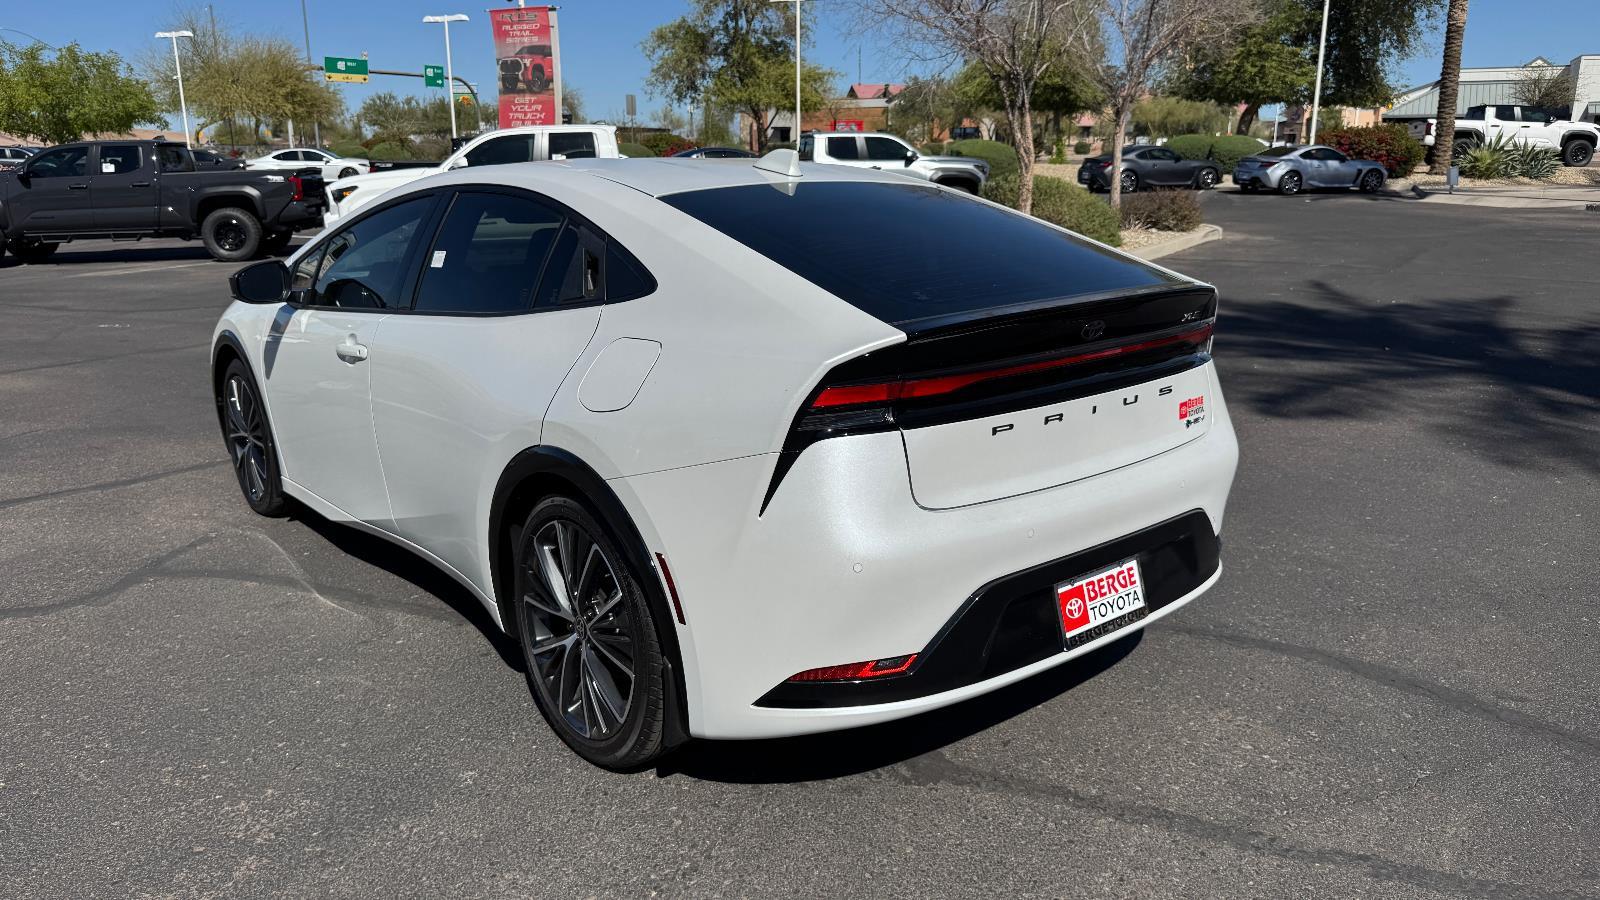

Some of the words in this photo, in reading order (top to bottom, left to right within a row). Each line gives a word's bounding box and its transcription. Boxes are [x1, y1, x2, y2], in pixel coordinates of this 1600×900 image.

[502, 23, 540, 31] RUGGED
[508, 112, 546, 120] TRUCK
[511, 104, 542, 112] YOUR
[991, 385, 1174, 437] PRIUS
[1085, 566, 1137, 603] BERGE
[1089, 589, 1141, 621] TOYOTA
